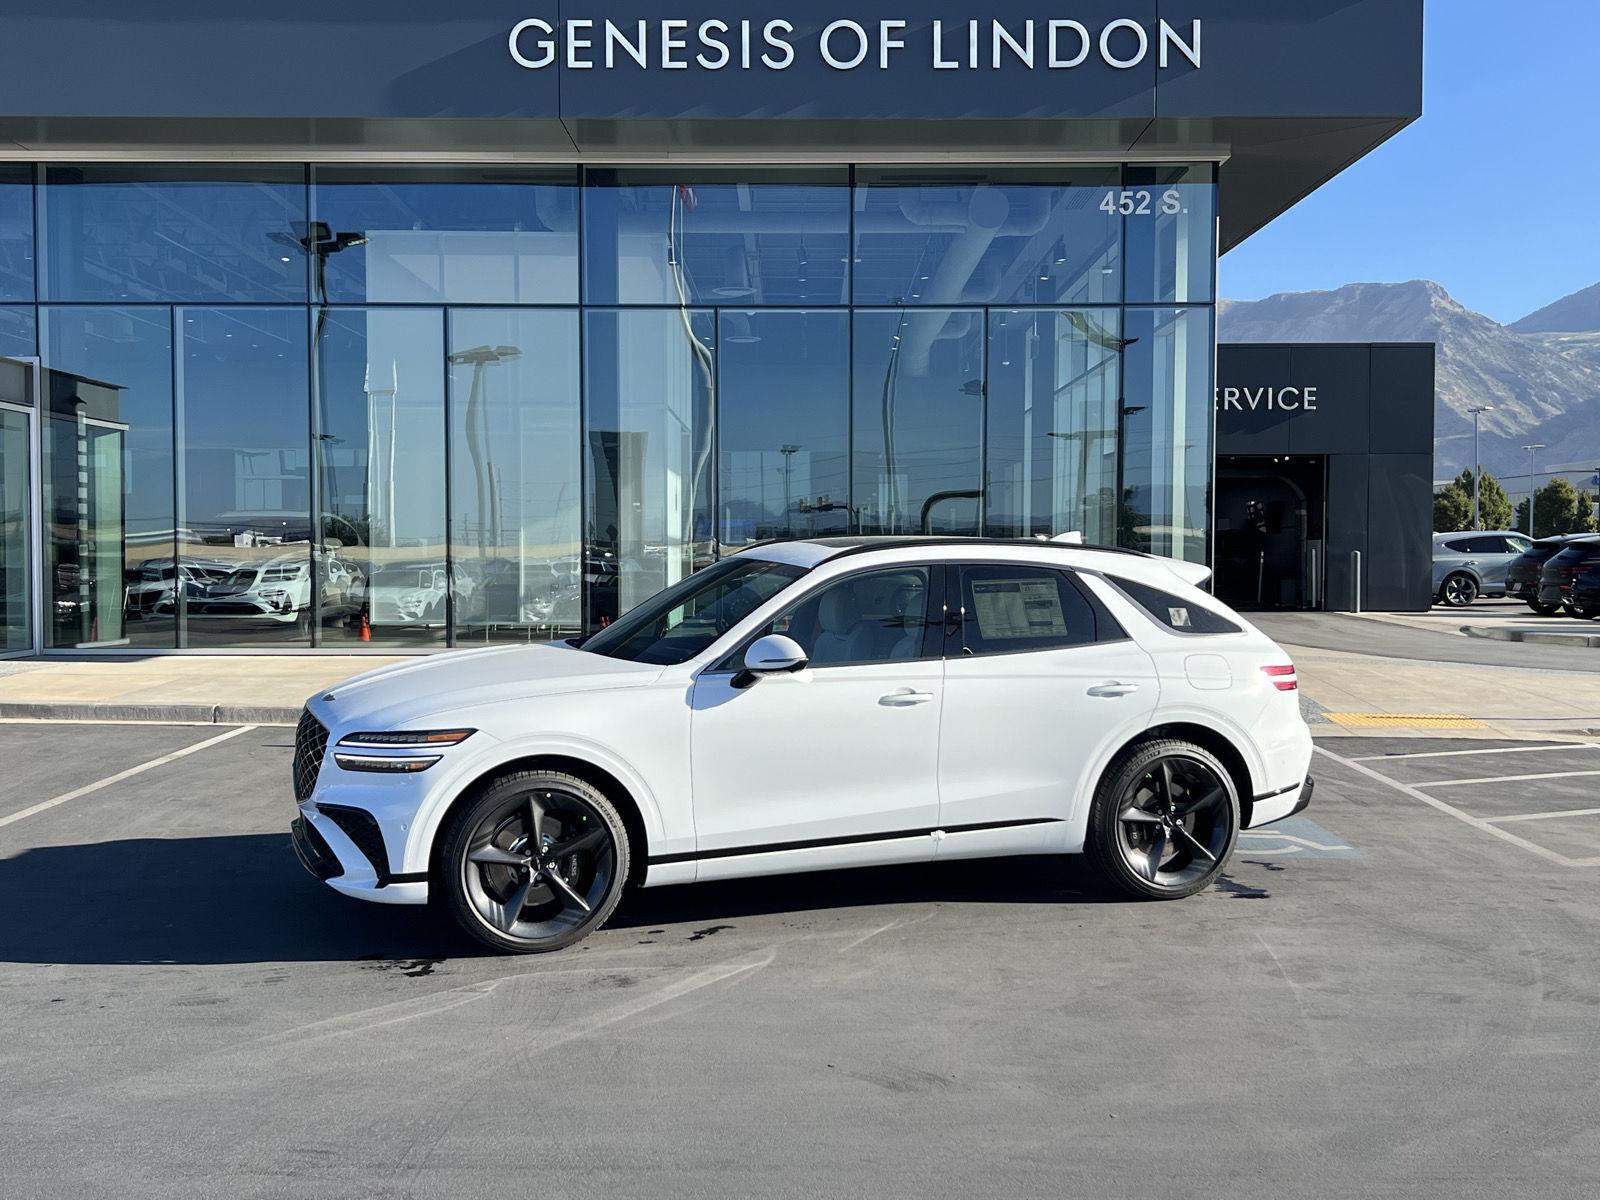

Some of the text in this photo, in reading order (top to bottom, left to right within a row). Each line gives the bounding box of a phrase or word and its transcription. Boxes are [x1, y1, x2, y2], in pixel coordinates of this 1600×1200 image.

[508, 18, 1203, 71] GENESIS OF LINDON
[1099, 189, 1189, 215] 452 S.
[1215, 386, 1317, 411] RVICE
